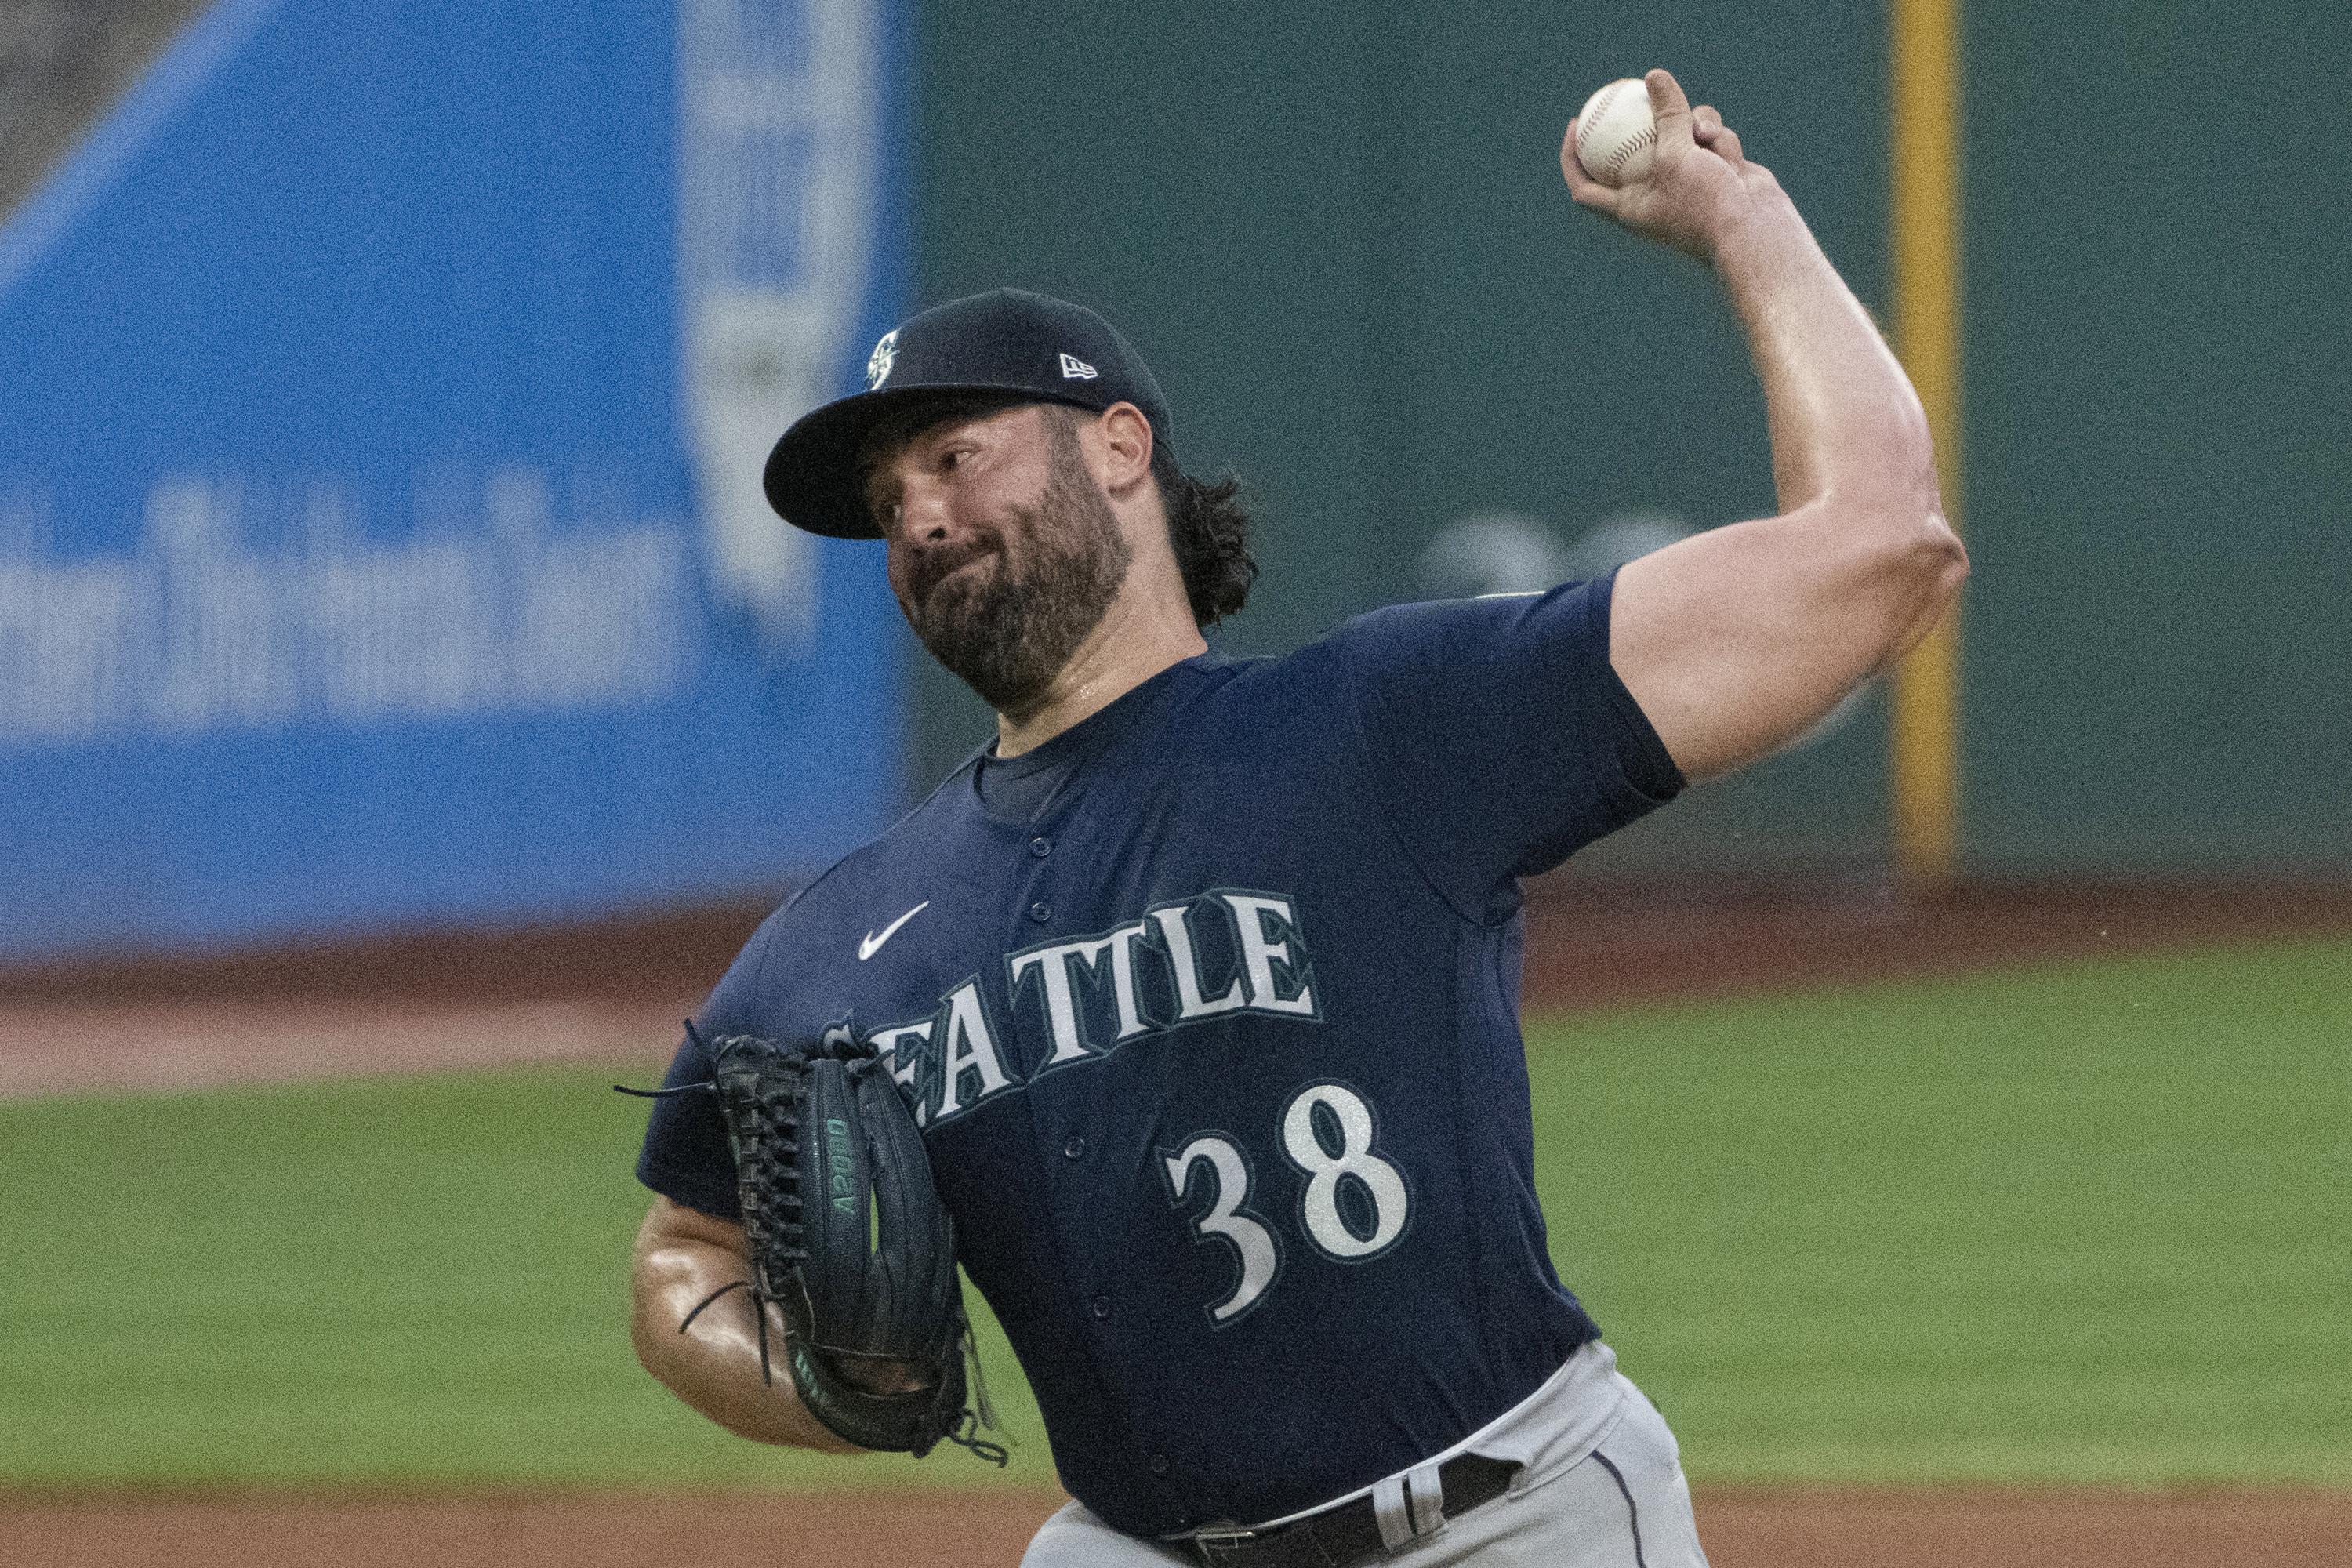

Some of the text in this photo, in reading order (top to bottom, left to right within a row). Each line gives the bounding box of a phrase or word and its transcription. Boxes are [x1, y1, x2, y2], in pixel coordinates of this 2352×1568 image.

[820, 889, 1321, 1134] EATTLE
[826, 1118, 856, 1216] A2000
[1158, 1080, 1411, 1327] 38
